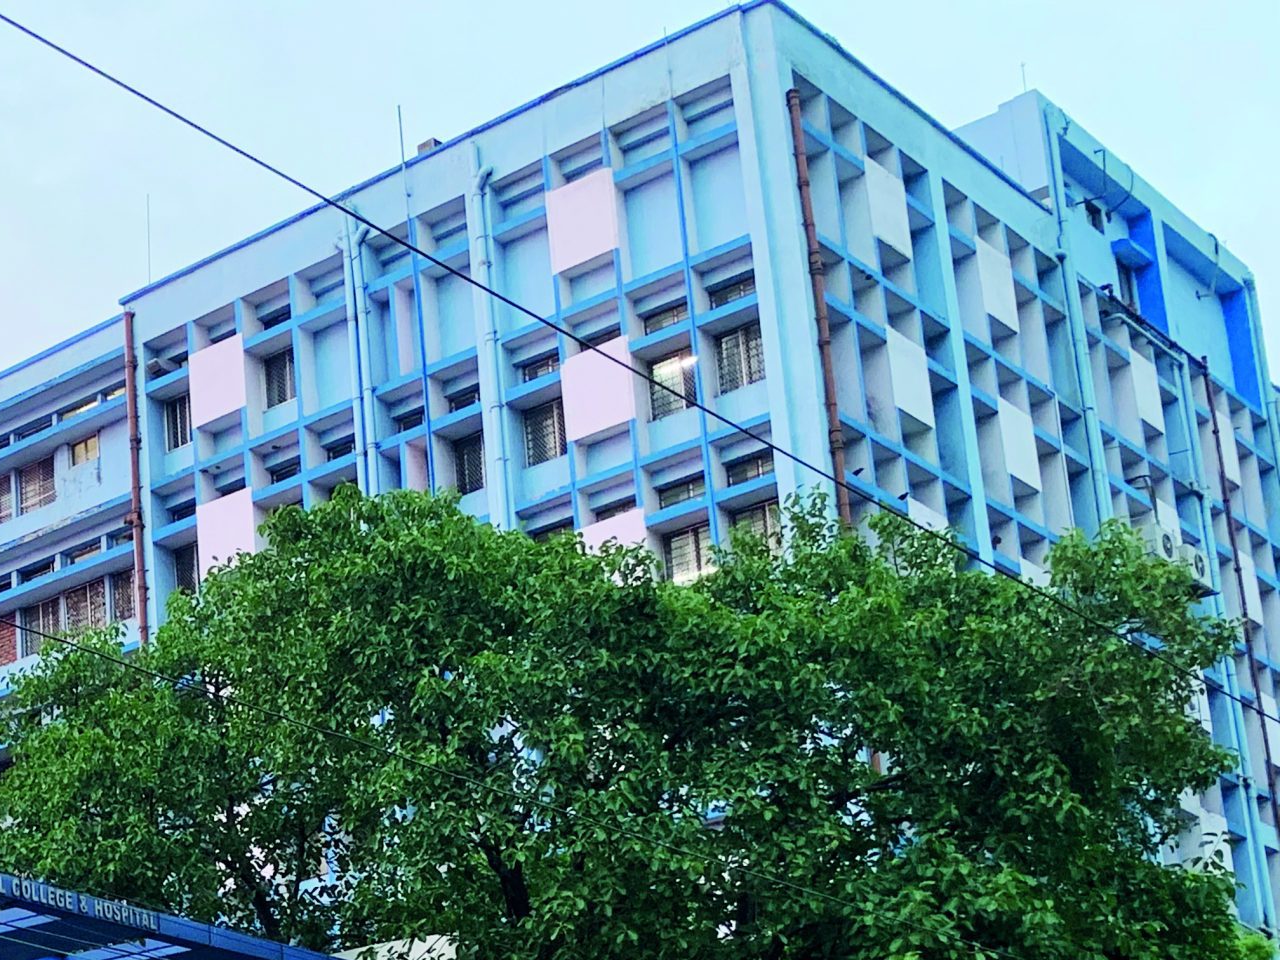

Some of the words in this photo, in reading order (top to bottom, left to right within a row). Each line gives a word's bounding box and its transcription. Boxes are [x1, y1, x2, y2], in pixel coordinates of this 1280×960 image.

[12, 879, 74, 910] COLLEGE
[80, 895, 89, 912] &
[95, 900, 158, 931] HOSPITAL
